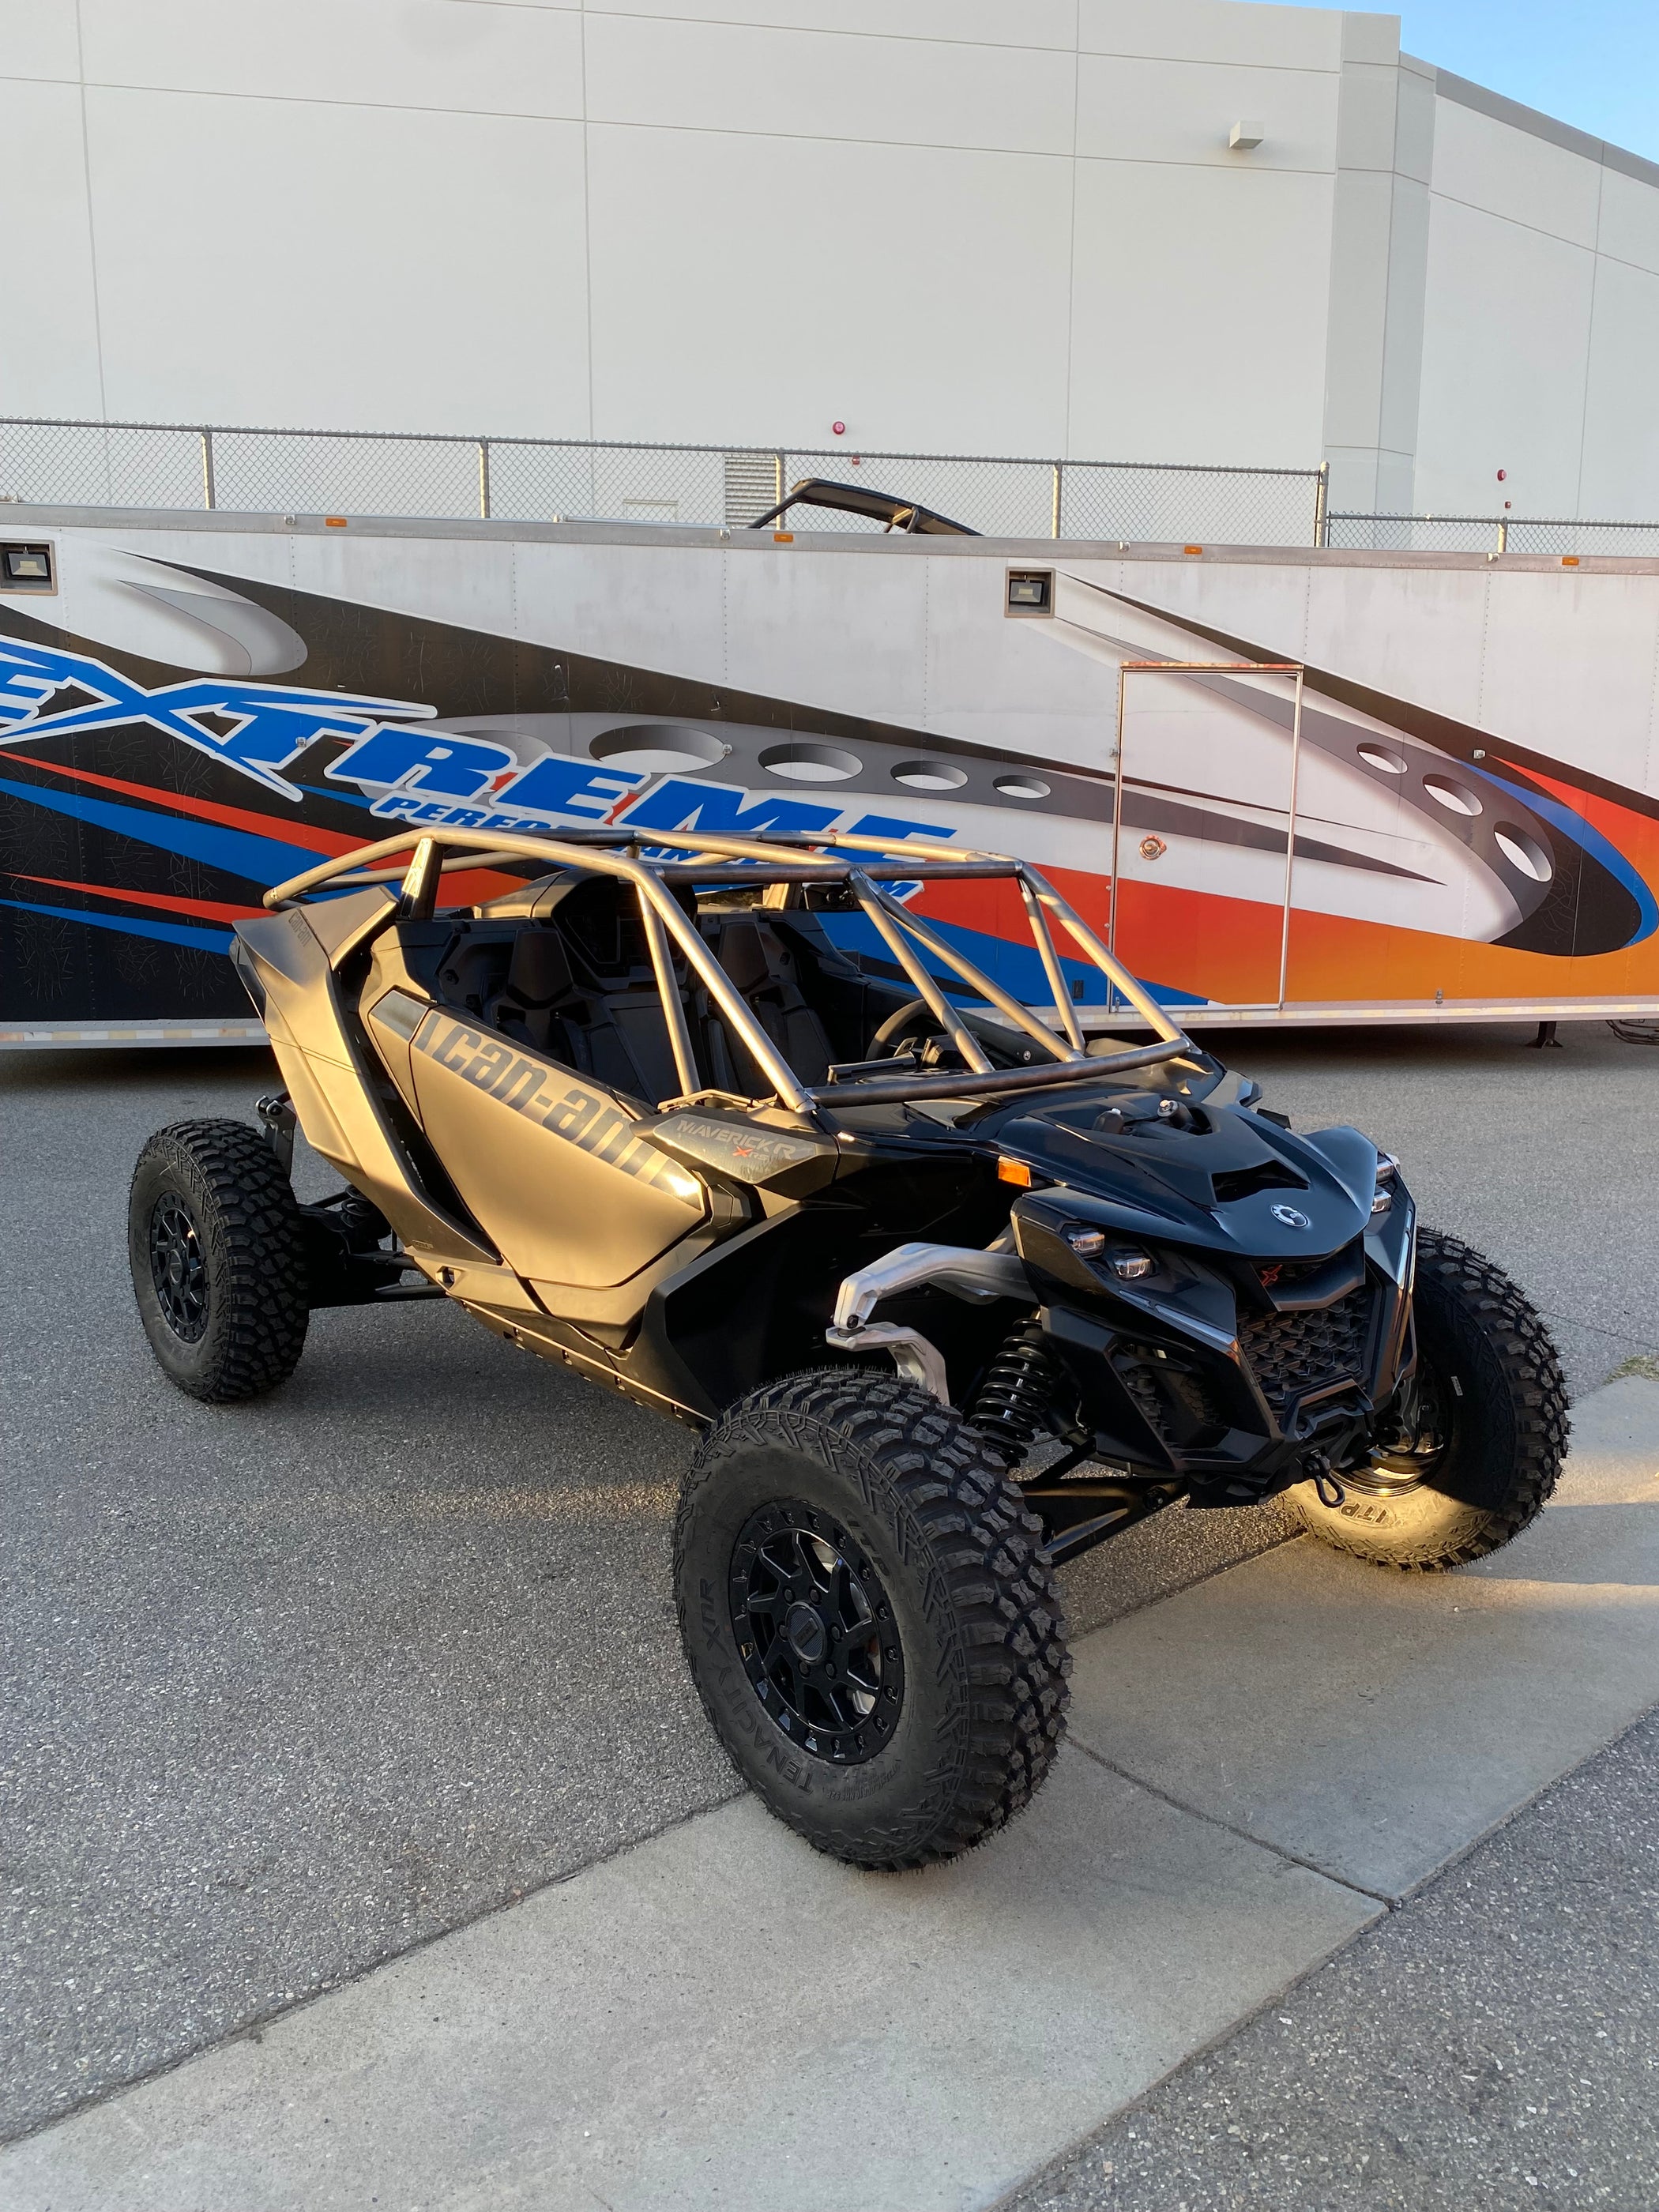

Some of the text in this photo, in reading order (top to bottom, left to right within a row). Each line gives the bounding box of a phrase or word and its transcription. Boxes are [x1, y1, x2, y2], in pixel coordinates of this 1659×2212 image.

[431, 1025, 658, 1177] can-am
[676, 1119, 796, 1160] MAVERICK R
[1341, 1503, 1387, 1524] ITP
[707, 1663, 814, 1795] TENACITY
